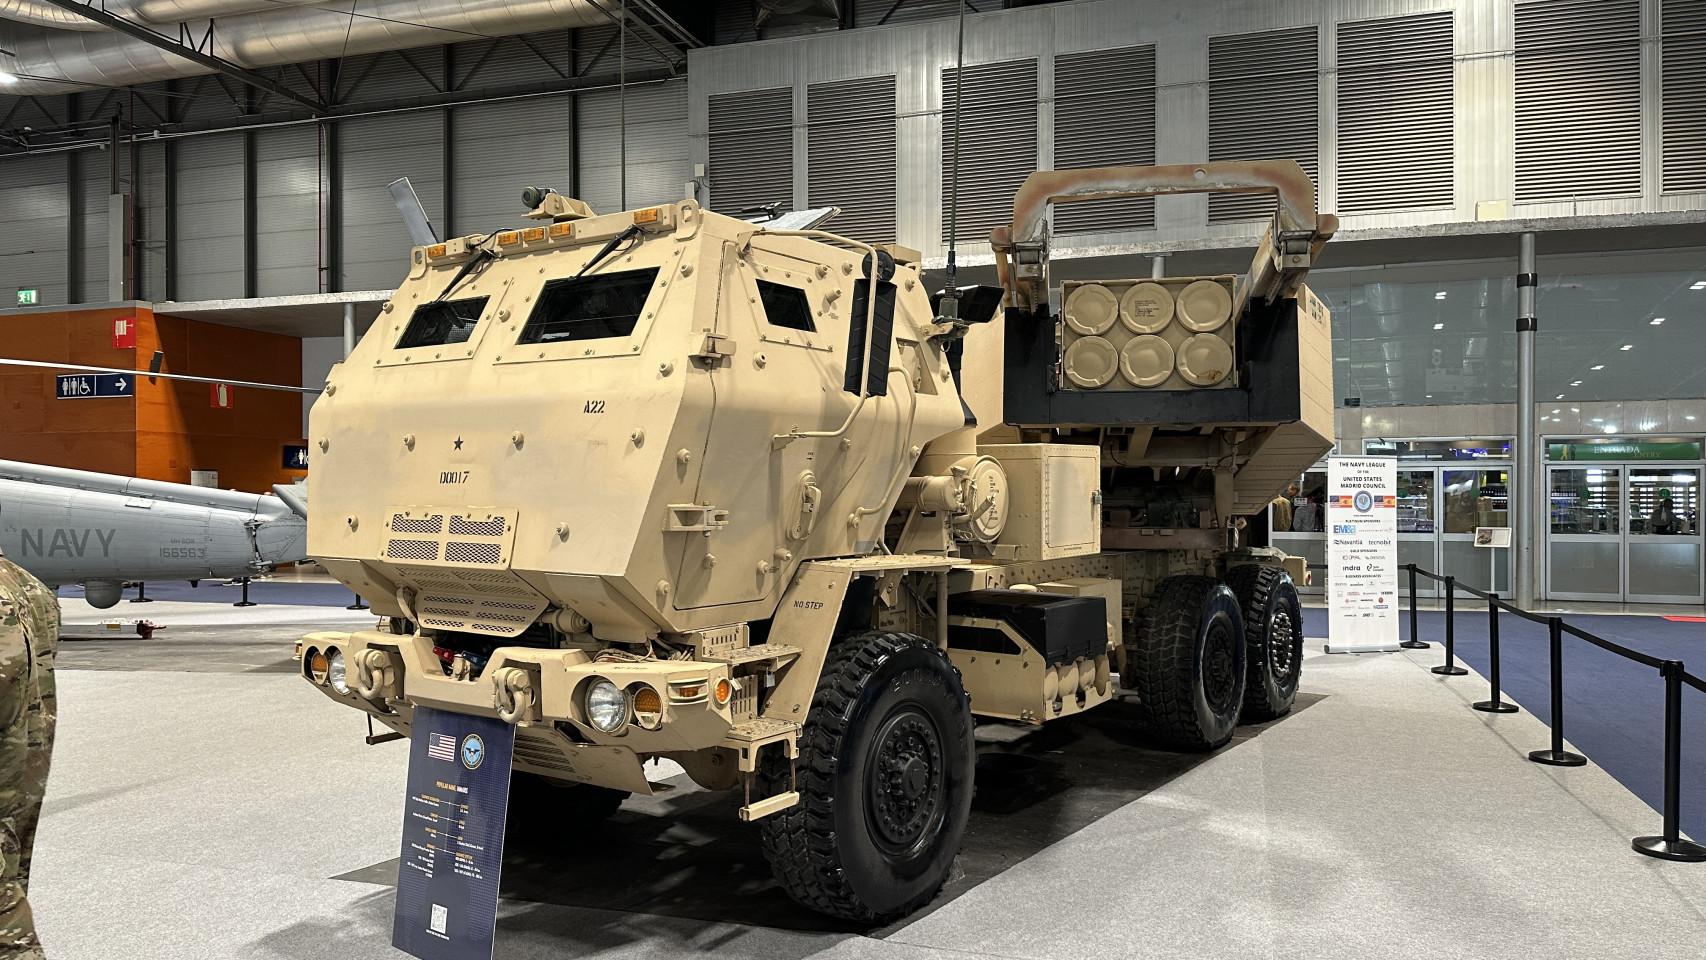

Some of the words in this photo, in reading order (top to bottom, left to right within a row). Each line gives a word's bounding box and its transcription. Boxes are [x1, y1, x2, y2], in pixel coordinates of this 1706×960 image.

[584, 400, 605, 414] A22
[1594, 446, 1640, 454] ENTRADA
[22, 528, 116, 557] NAVY
[160, 548, 204, 557] 166563
